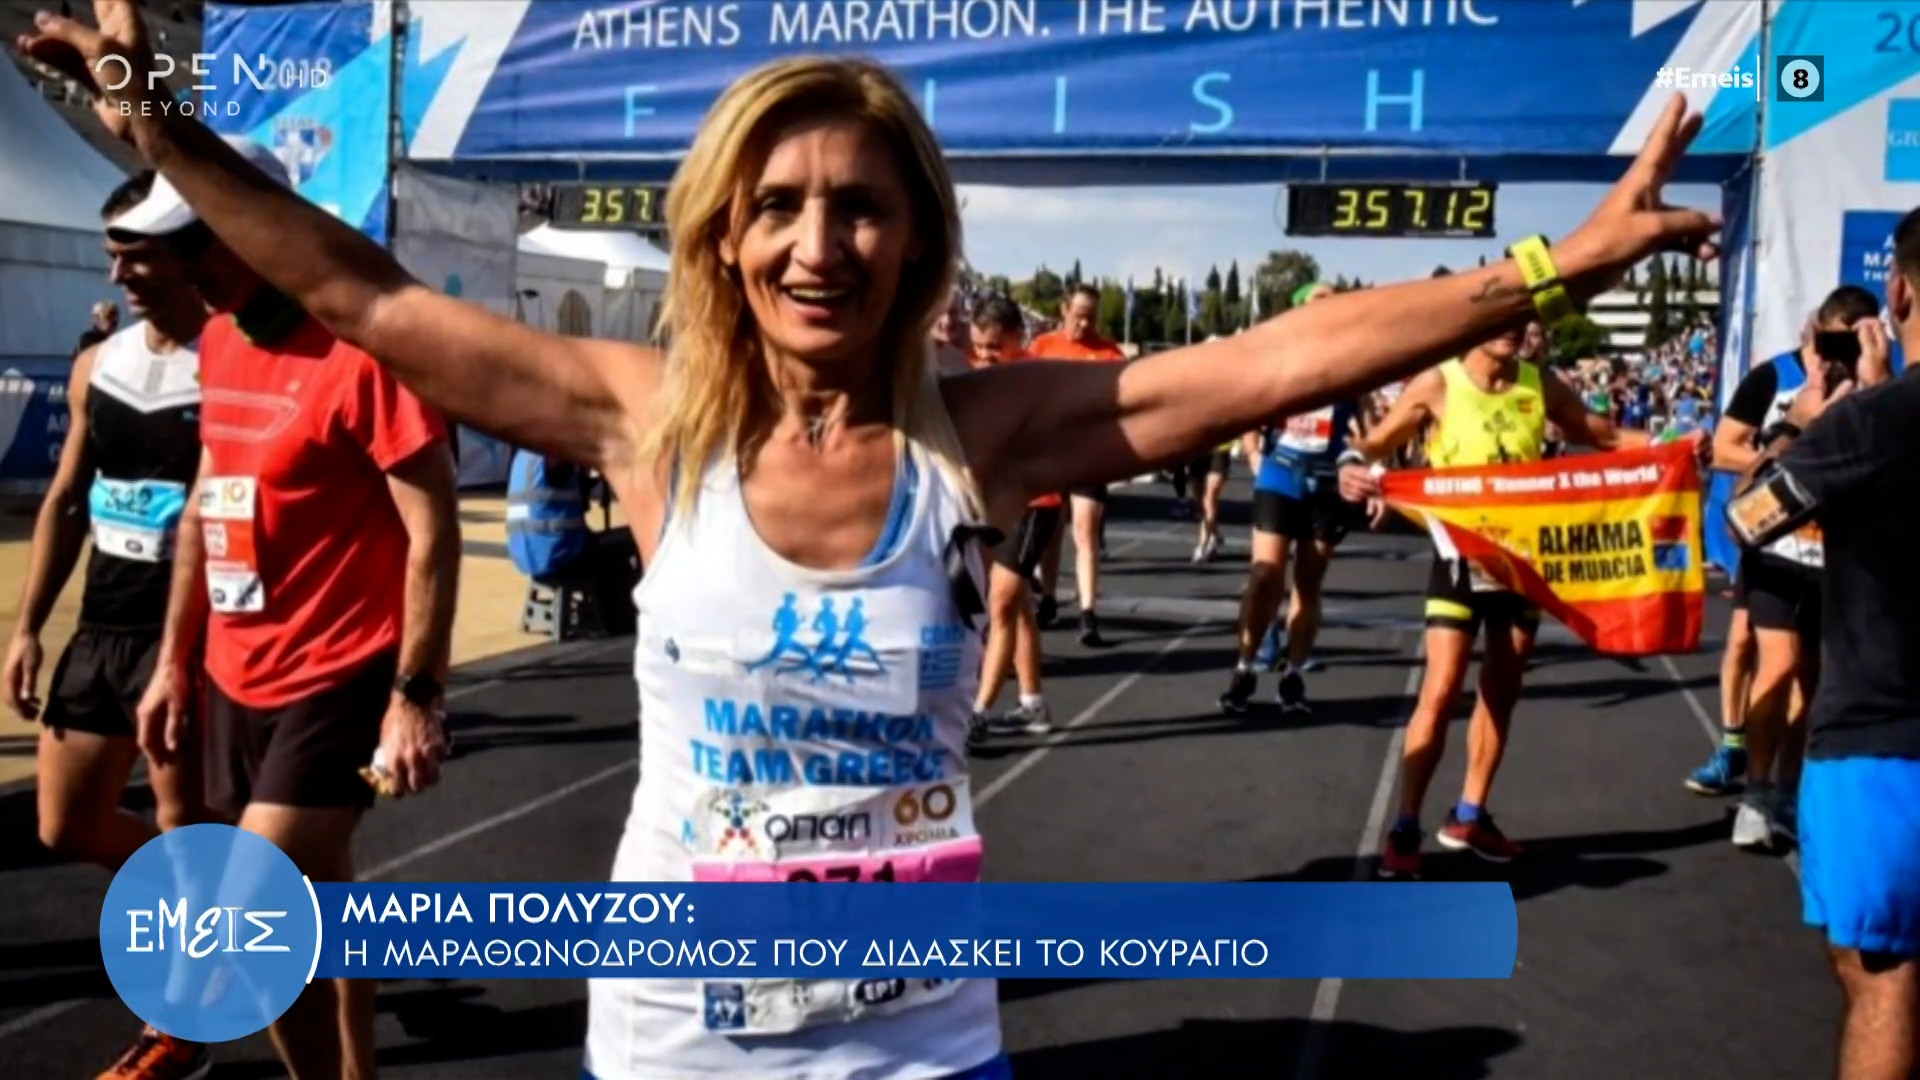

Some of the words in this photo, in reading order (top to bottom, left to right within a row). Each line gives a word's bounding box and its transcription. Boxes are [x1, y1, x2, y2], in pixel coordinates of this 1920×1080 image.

[573, 4, 740, 50] ATHENS
[769, 0, 1050, 44] MARATHON.
[1078, 0, 1166, 33] THE
[1185, 0, 1499, 31] AUTHENTIC
[1538, 519, 1644, 556] ALHAMA
[1543, 564, 1564, 584] DE
[1569, 554, 1646, 583] MURCIA
[690, 738, 794, 785] TEAM
[893, 784, 957, 826] 60
